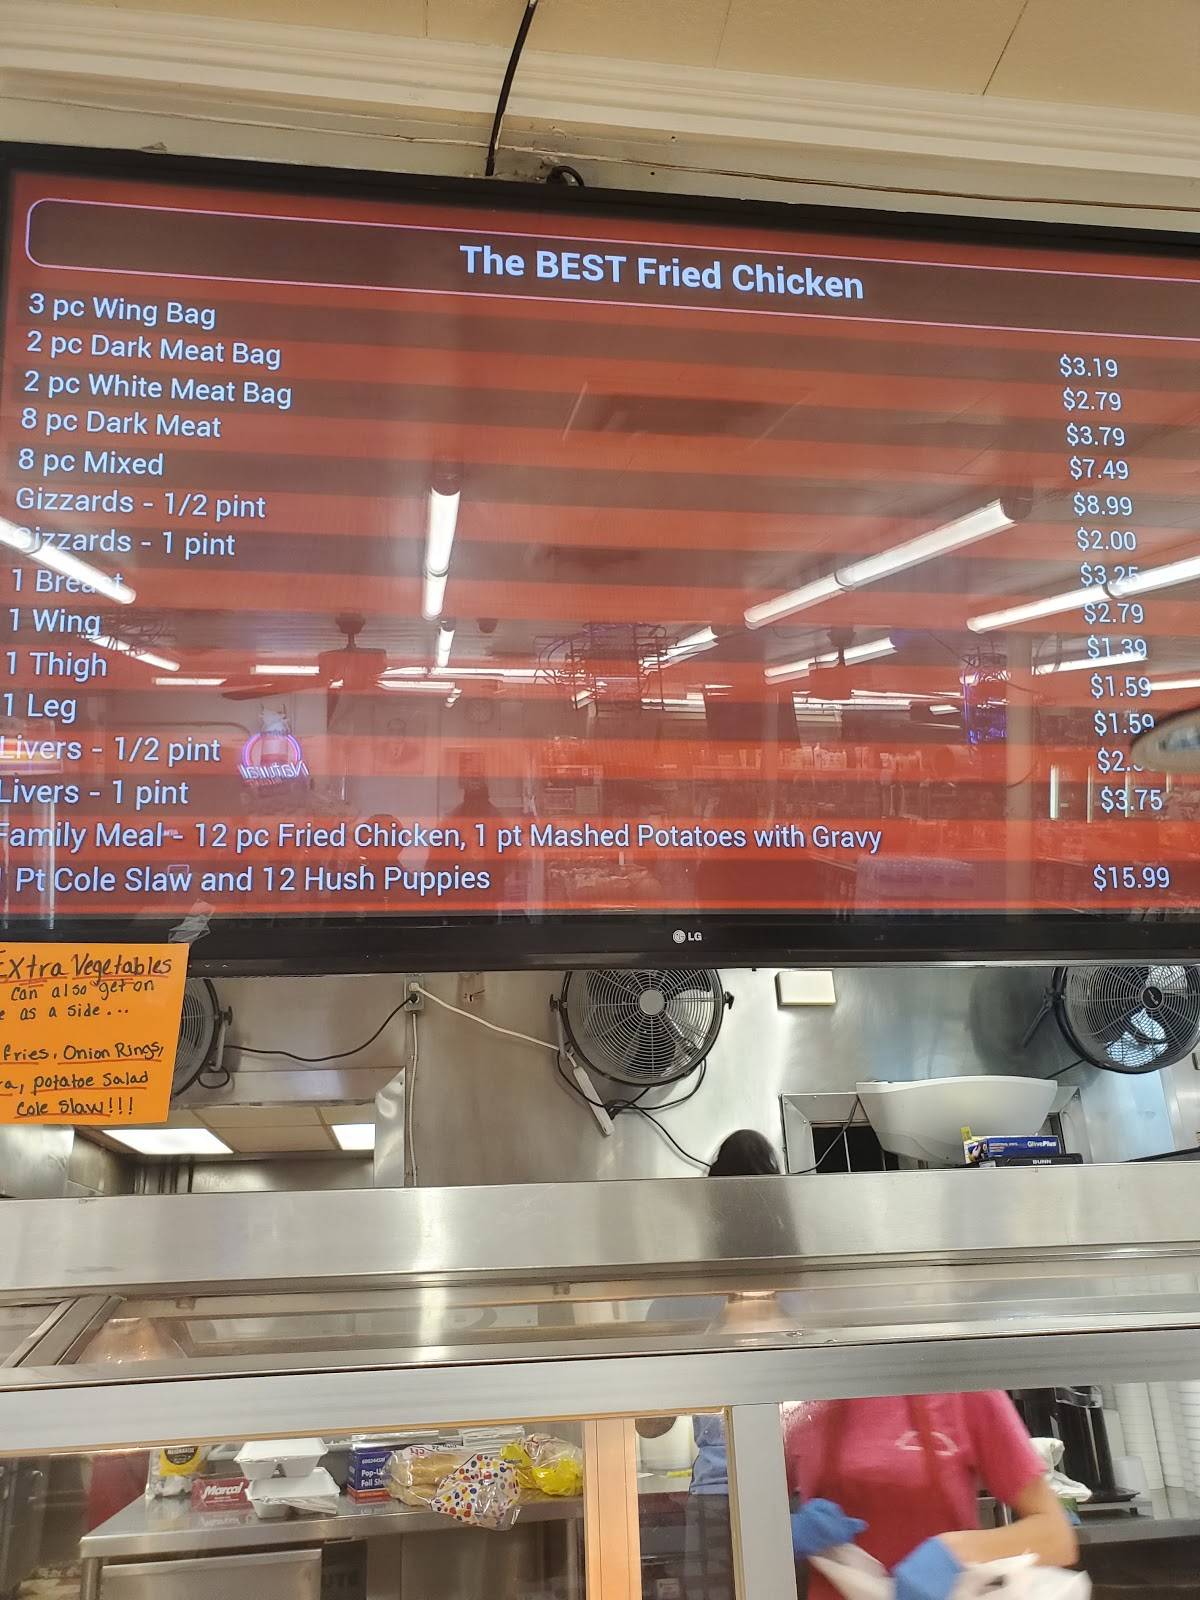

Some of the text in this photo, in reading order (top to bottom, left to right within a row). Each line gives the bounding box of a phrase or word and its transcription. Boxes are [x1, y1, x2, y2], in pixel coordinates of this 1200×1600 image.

[460, 246, 863, 299] The BEST Fried Chicken
[29, 293, 216, 329] 3 pc Wing Bag
[26, 331, 281, 370] 2 pc Dark Meat Bag
[1059, 353, 1118, 376] $3.19
[24, 371, 292, 409] 2 pc White Meat Bag
[1063, 387, 1121, 411] $2.79
[22, 408, 221, 438] 8 pc Dark Meat
[1066, 423, 1125, 447] $3.79
[18, 448, 164, 476] 8 pc Mixed
[1070, 456, 1129, 479] $7.49
[16, 487, 134, 514] Gizzards
[165, 493, 207, 518] 1/2
[216, 494, 266, 522] pint
[1073, 492, 1132, 515] $8.99
[163, 531, 172, 553] 1
[185, 533, 235, 560] pint
[1076, 527, 1136, 551] $2.00
[12, 569, 124, 594] 1 Breat
[9, 608, 101, 638] 1 Wing
[1084, 602, 1144, 624] $2.79
[7, 652, 107, 682] 1 Thigh
[1090, 673, 1152, 699] $1.59
[4, 694, 76, 723] 1 Leg
[1094, 710, 1155, 736] $1.59
[0, 735, 81, 760] Livers
[114, 736, 159, 762] 1/2
[168, 736, 220, 766] pint
[1097, 747, 1156, 774] $2.
[0, 780, 79, 803] Livers
[113, 780, 123, 803] 1
[135, 780, 188, 810] pint
[1101, 786, 1163, 813] $3.75
[95, 823, 163, 847] Meal
[196, 823, 228, 847] 12
[236, 829, 269, 852] pc
[278, 823, 345, 847] Fried
[354, 823, 465, 851] Chicken,
[475, 824, 486, 846] 1
[497, 826, 522, 851] pt
[530, 824, 628, 847] Mashed
[639, 825, 746, 847] Potatoes
[754, 825, 805, 848] with
[812, 826, 881, 853] Gravy
[15, 867, 45, 892] Pt
[54, 867, 114, 892] Cole
[125, 867, 191, 892] Slaw
[201, 867, 252, 892] and
[263, 868, 295, 891] 12
[305, 867, 375, 891] Hush
[384, 867, 490, 896] Puppies
[1093, 865, 1170, 892] $15.99
[687, 931, 703, 942] LG
[72, 953, 172, 984] Vegetables
[52, 984, 87, 999] also
[100, 977, 126, 1000] get
[134, 979, 154, 992] on
[20, 1007, 36, 1020] as
[49, 1006, 57, 1017] a
[64, 1045, 110, 1061] Onion
[361, 1478, 373, 1488] Foil
